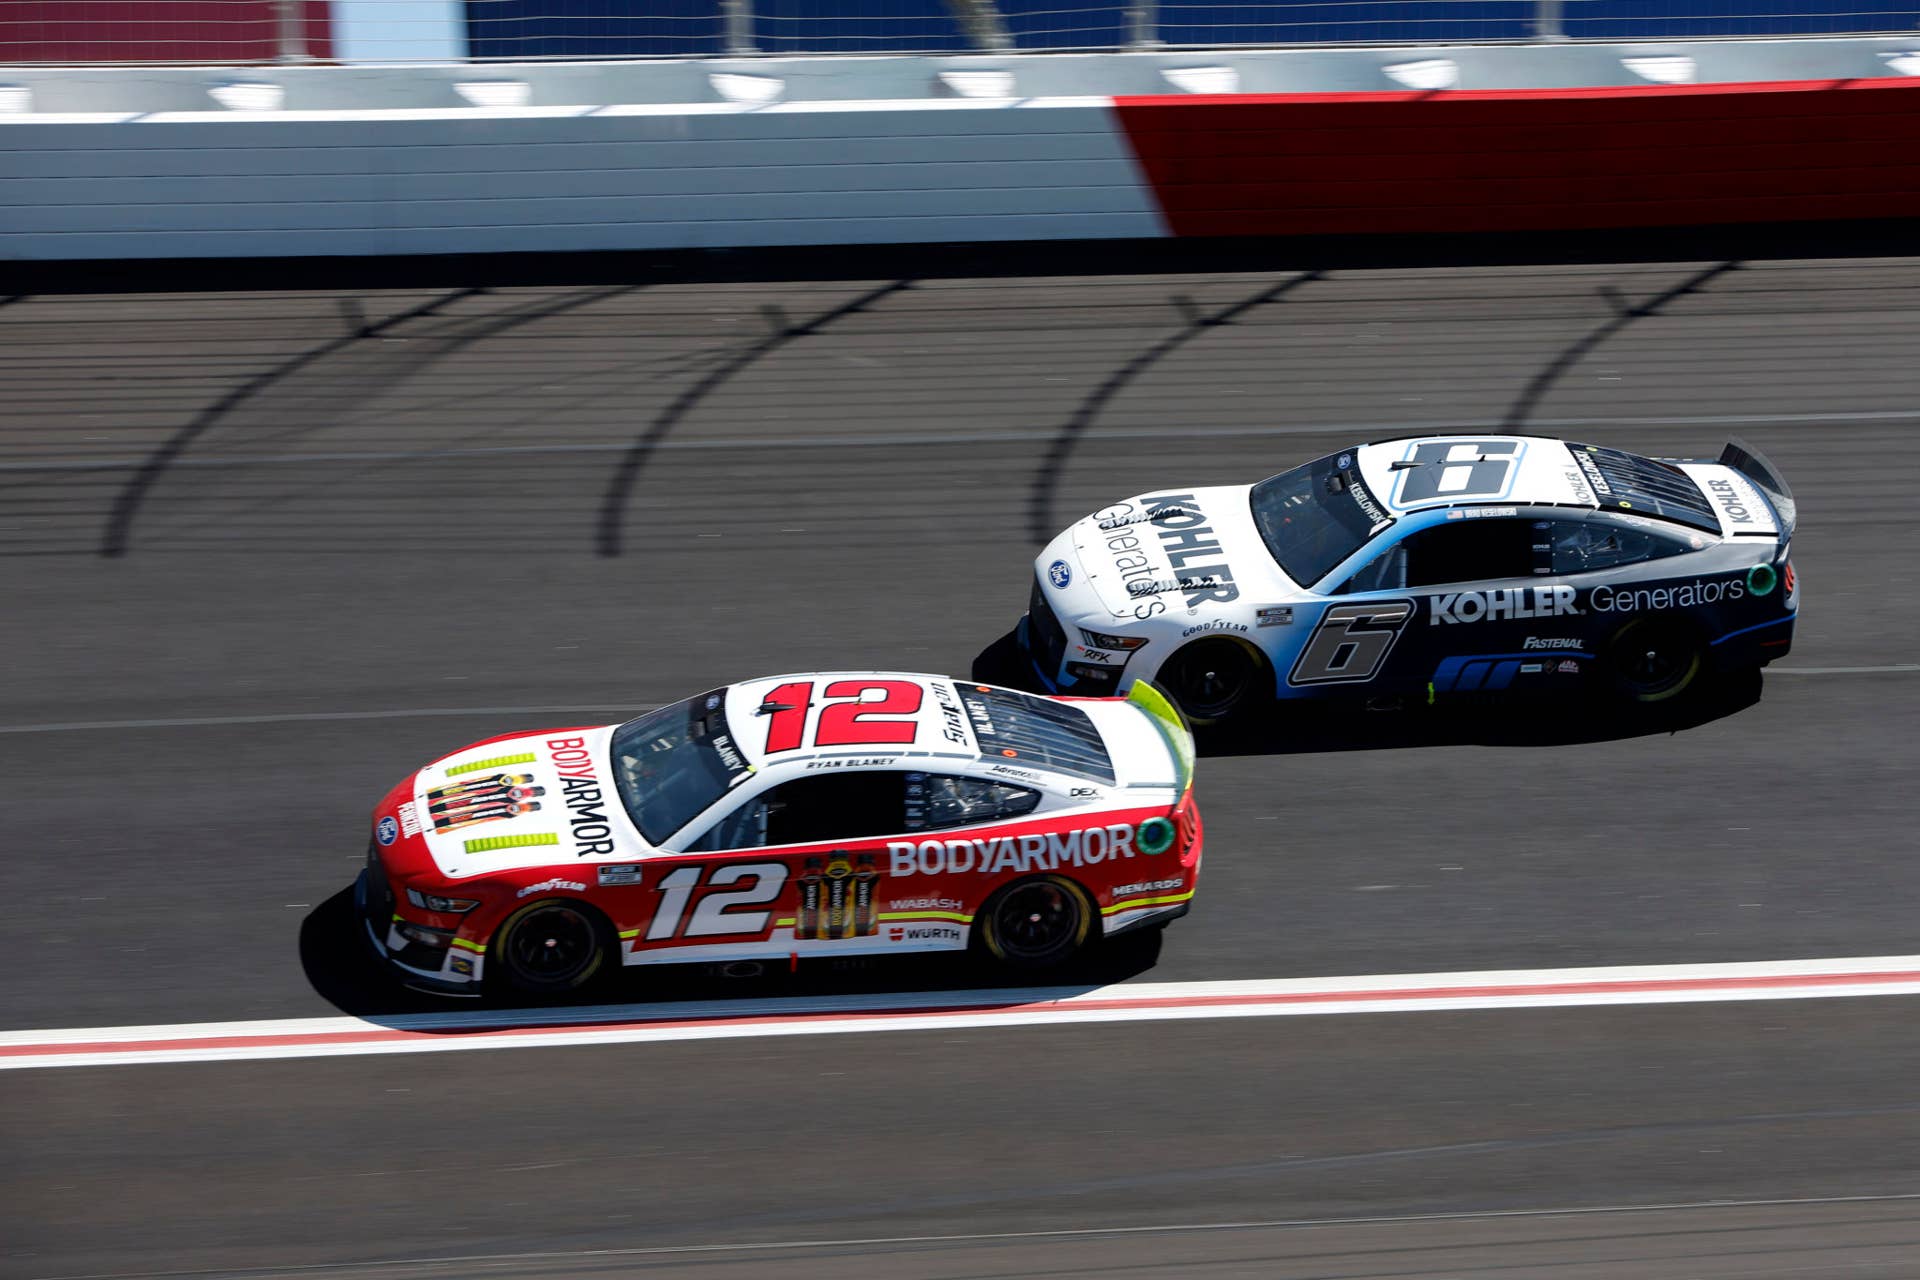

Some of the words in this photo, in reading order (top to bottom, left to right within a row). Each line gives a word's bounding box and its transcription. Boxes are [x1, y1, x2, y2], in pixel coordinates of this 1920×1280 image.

[1396, 440, 1520, 505] 6
[1348, 482, 1387, 524] KESELOWSK
[1708, 479, 1753, 524] KOHLER
[1139, 494, 1240, 609] KOHLER
[1049, 560, 1071, 586] Ford
[1430, 585, 1579, 626] KOHLER
[1590, 578, 1744, 613] Generators
[1182, 619, 1248, 638] GOODYEAR
[1289, 598, 1415, 686] 6
[1523, 637, 1584, 650] FASTENAL
[1084, 649, 1111, 664] RFK
[763, 680, 925, 756] 12
[712, 735, 745, 772] BLANEY
[805, 759, 842, 769] RYAN
[846, 757, 897, 768] BLANEY
[547, 736, 615, 857] BODYARMOR
[1070, 787, 1100, 797] DEX
[887, 823, 1135, 877] BODYARMOR
[645, 860, 790, 943] 12
[889, 898, 962, 911] WABASH
[1112, 878, 1184, 897] MENARDS
[907, 928, 960, 941] WÜRTH
